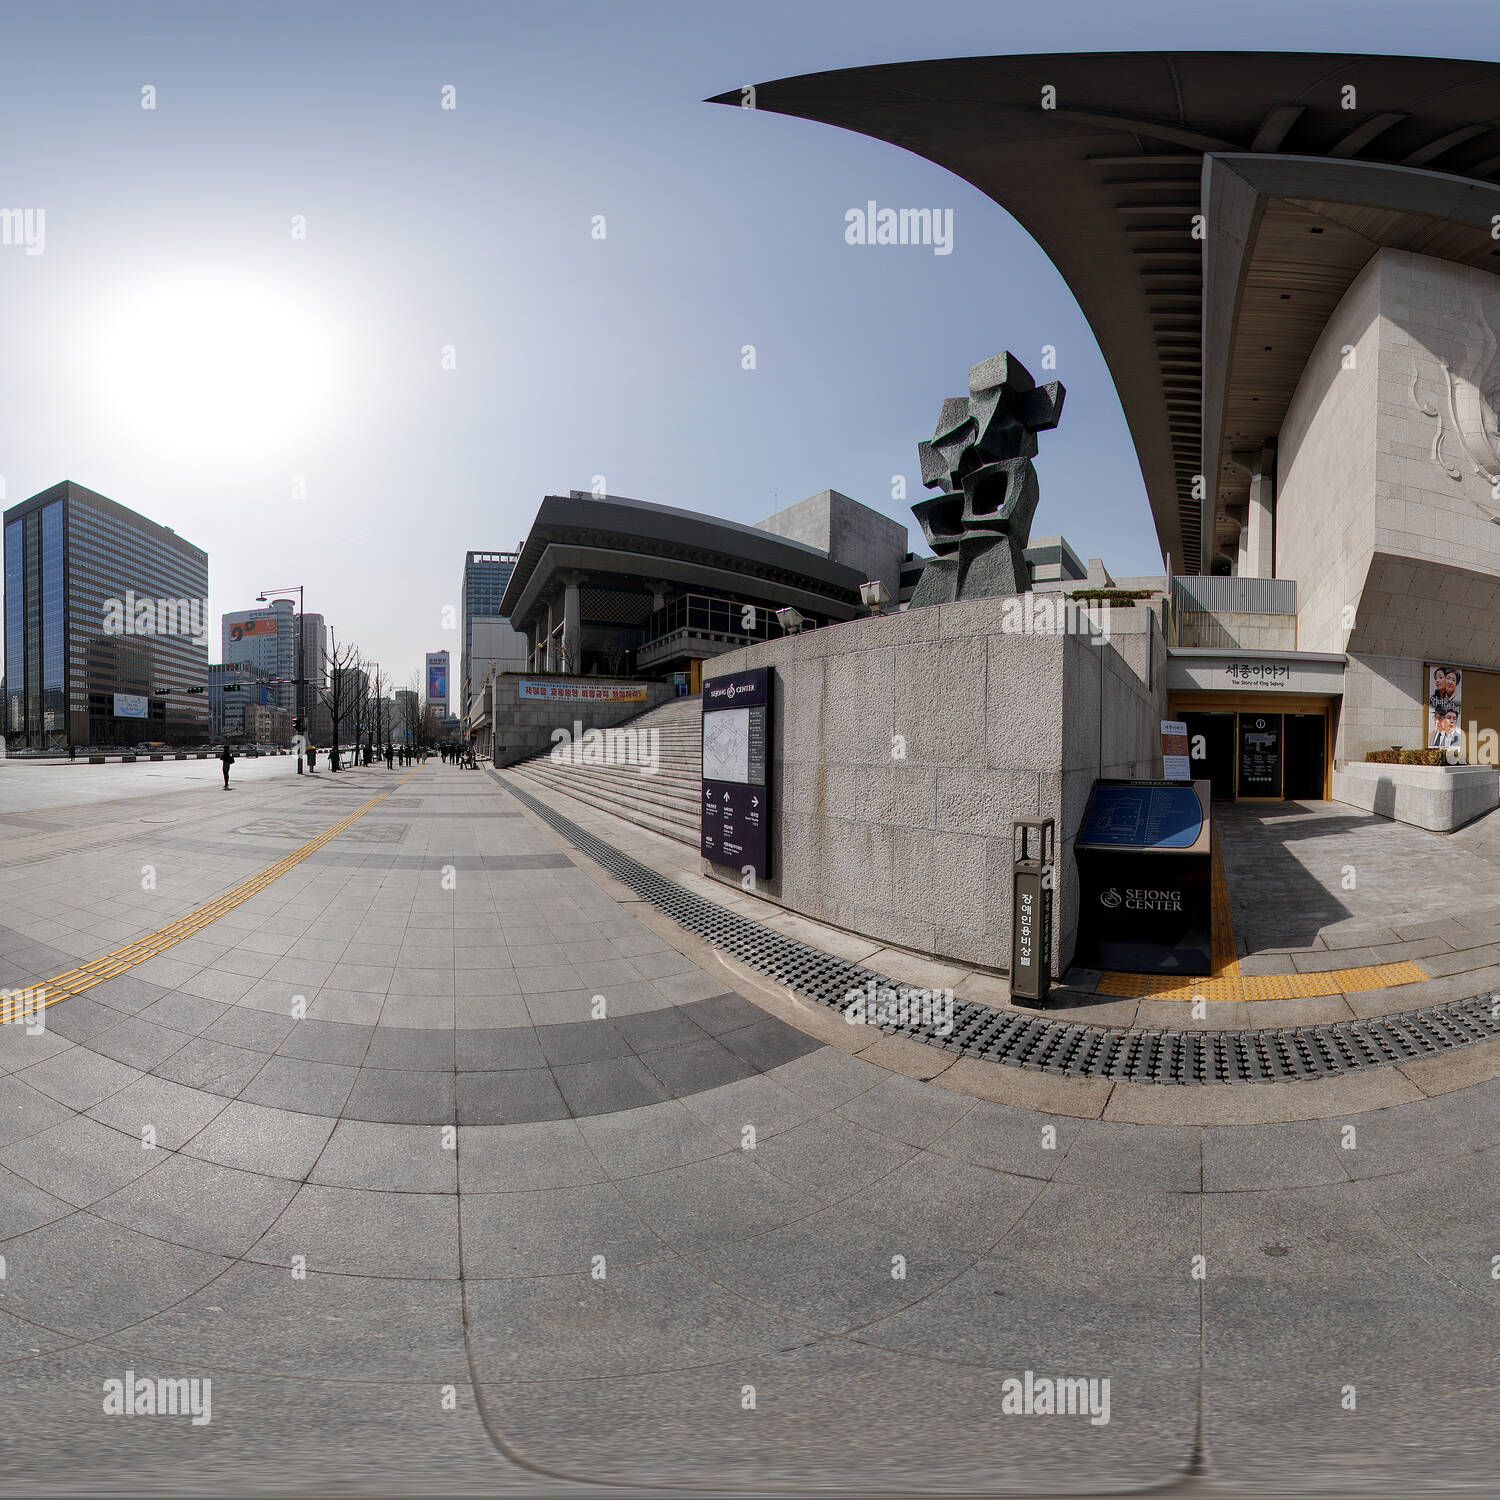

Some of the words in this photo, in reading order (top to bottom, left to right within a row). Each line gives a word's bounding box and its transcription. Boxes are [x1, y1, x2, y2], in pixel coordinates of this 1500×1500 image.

[1225, 664, 1290, 680] 세종이야기
[710, 687, 727, 698] SEJONG
[735, 684, 755, 694] CENTER
[1125, 888, 1182, 901] SEJONG
[1125, 899, 1183, 911] CENTER
[1020, 893, 1034, 967] 장애인용비상벨
